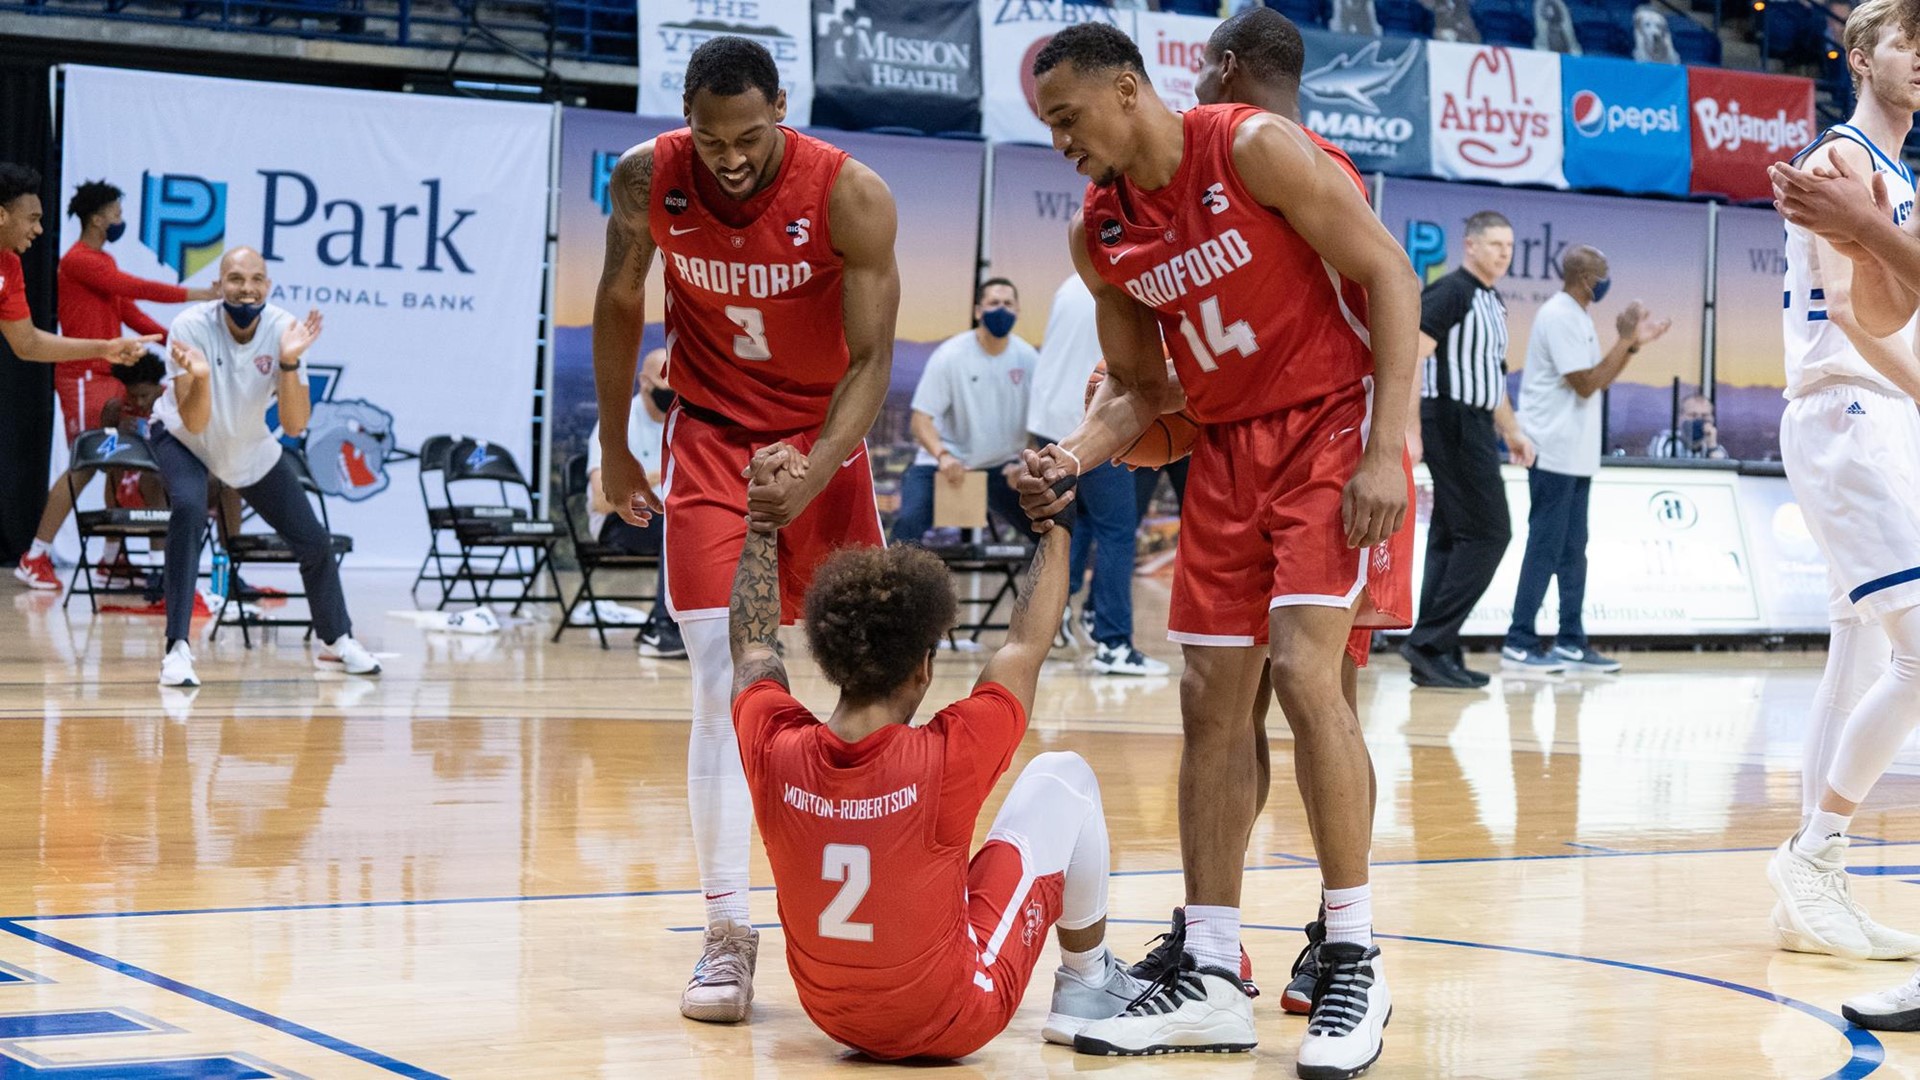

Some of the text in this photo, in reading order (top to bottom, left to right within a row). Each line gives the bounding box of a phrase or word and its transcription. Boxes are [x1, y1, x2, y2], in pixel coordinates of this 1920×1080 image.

[688, 0, 759, 19] THE
[856, 29, 971, 70] MISSION
[871, 63, 959, 95] HEALTH
[1306, 110, 1414, 143] MAKO
[1440, 91, 1549, 147] Arby's
[1607, 104, 1680, 135] pepsi
[1694, 97, 1808, 152] Bojangles
[257, 169, 476, 275] Park
[671, 251, 814, 299] RADFORD
[1124, 228, 1253, 309] RADFORD
[270, 284, 476, 312] ATIONAL BANK
[724, 304, 773, 361] 3
[1177, 294, 1260, 373] 14
[784, 782, 918, 820] MORTON-ROBERTSON
[818, 842, 875, 943] 2
